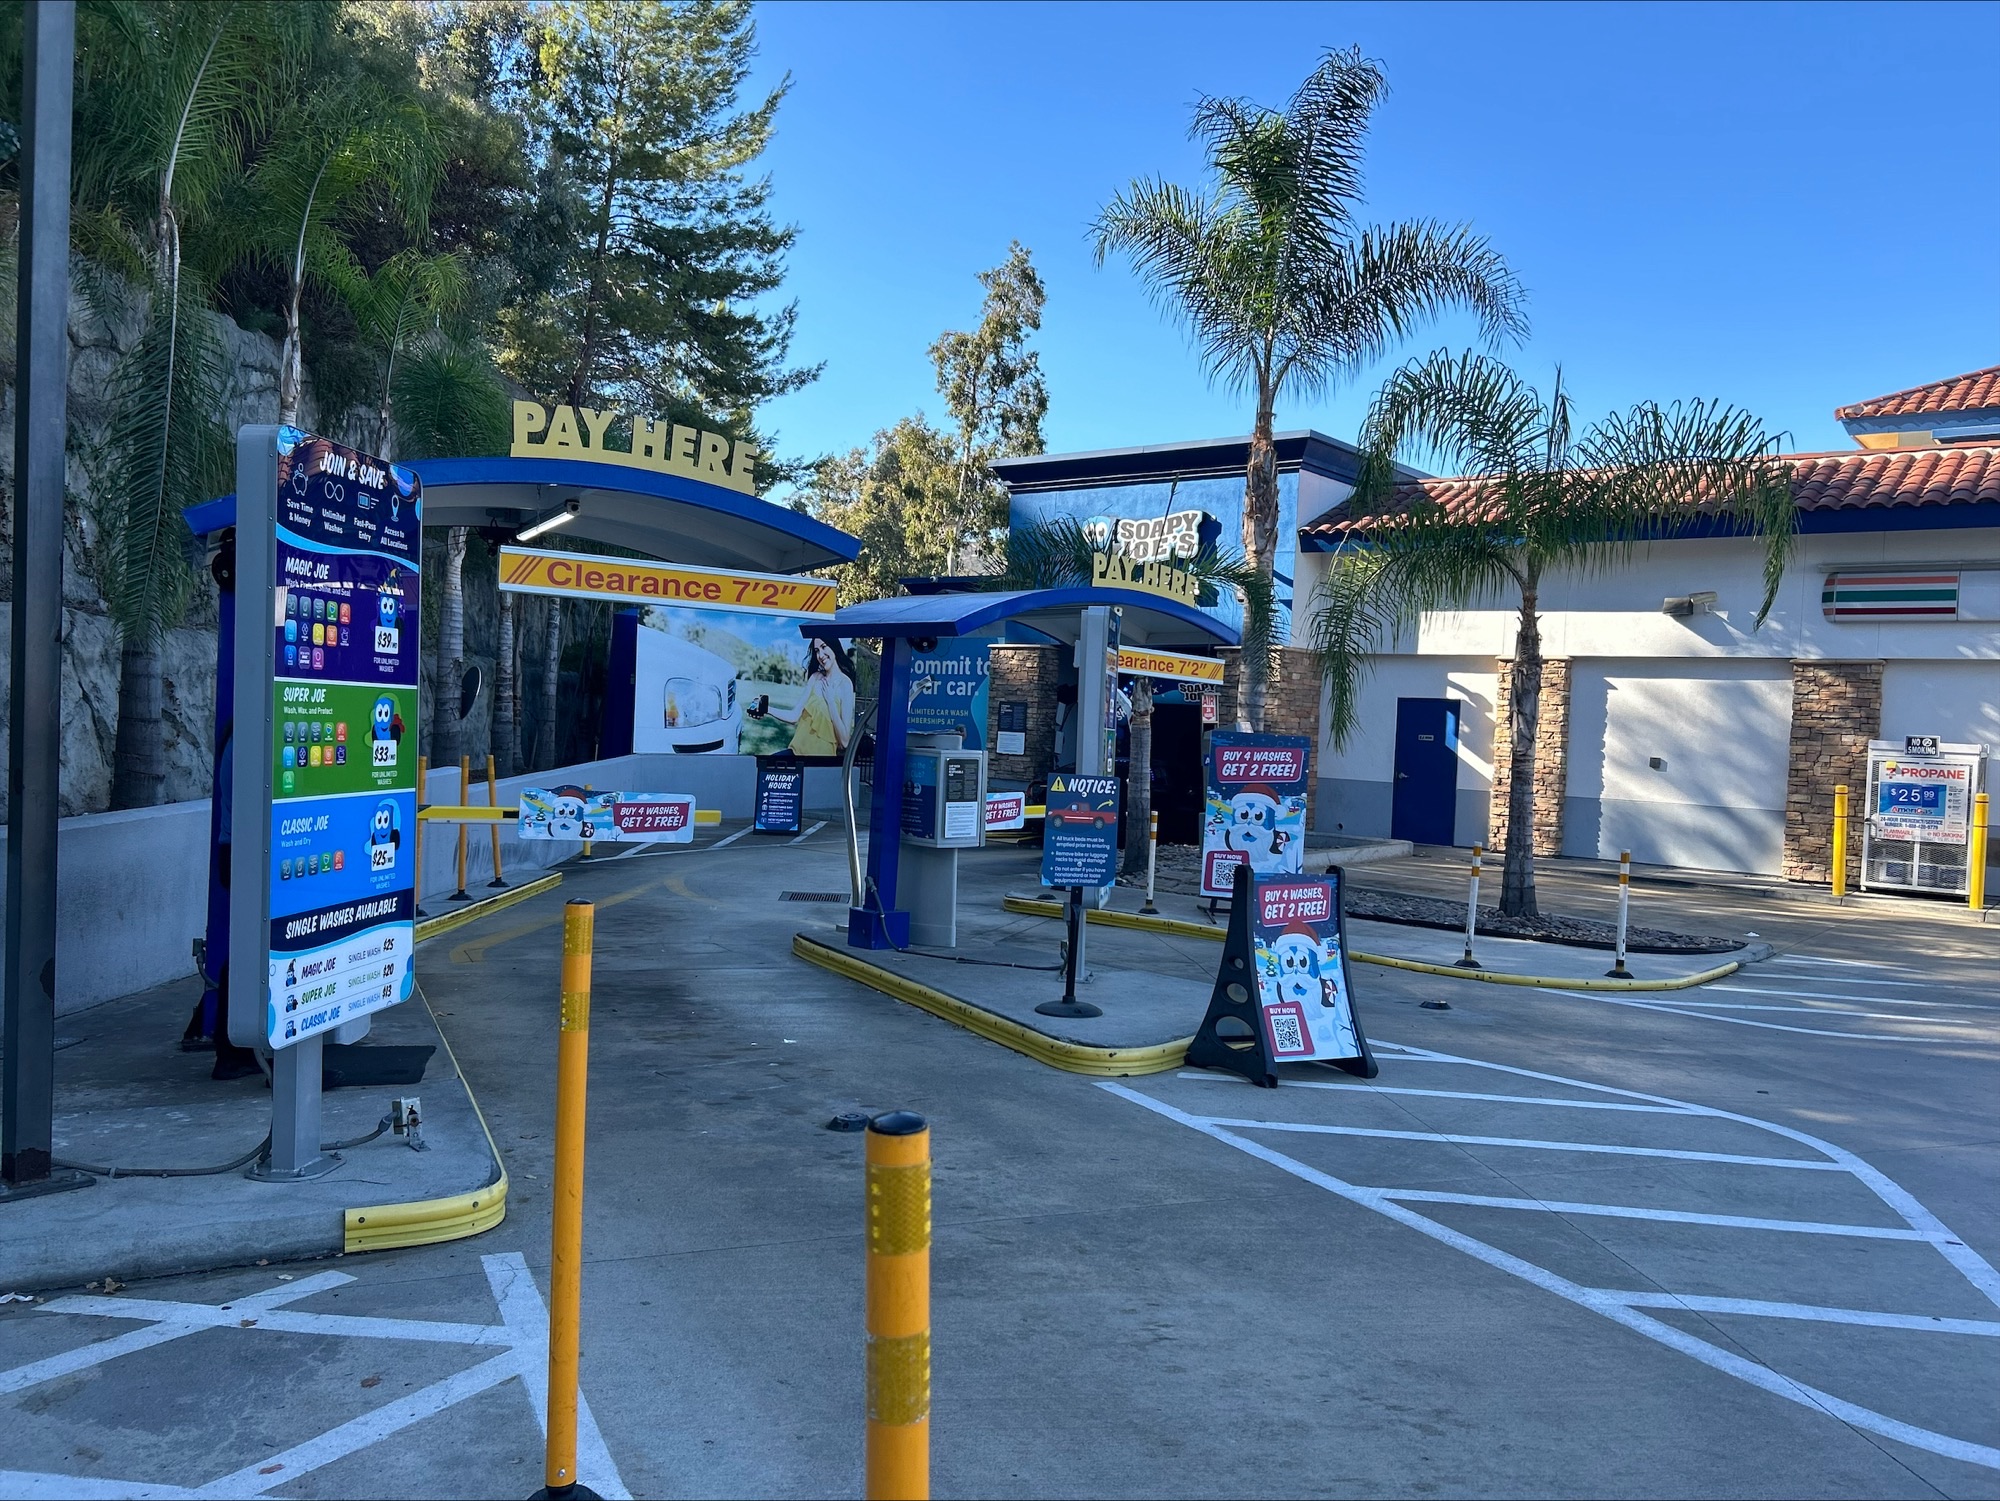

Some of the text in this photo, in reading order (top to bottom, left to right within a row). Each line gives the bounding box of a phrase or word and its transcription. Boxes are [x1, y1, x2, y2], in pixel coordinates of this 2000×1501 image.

[513, 400, 758, 484] PAY HERE
[320, 451, 385, 489] JOIN & SAVE
[287, 499, 313, 513] Save Time
[289, 512, 311, 527] & Money
[322, 509, 345, 522] Unlimited
[324, 522, 343, 533] Washes
[354, 518, 376, 530] Fast-Pass
[1120, 513, 1198, 540] SOAPY
[359, 531, 371, 542] Entry
[384, 526, 399, 537] Access
[388, 539, 408, 550] Locations
[285, 557, 329, 579] MAGIC JOE
[1093, 552, 1198, 601] PAY HERE
[547, 562, 796, 606] Clearance 7'2"
[1118, 655, 1206, 675] earance 7'2"
[284, 687, 326, 702] SUPER JOE
[947, 681, 978, 696] car.
[1179, 683, 1215, 692] SOAPY
[1203, 695, 1214, 705] AIR
[1912, 738, 1920, 746] NO
[1223, 752, 1293, 762] BUY 4 WASHES,
[1908, 746, 1935, 754] SMOKING
[1222, 764, 1297, 777] GET 2 FREE!
[1902, 768, 1965, 779] PROPANE
[765, 774, 796, 782] HOLIDAY
[1068, 779, 1116, 794] NOTICE:
[620, 806, 638, 816] BUY
[646, 806, 680, 816] WASHES,
[986, 811, 997, 820] GET
[1003, 808, 1019, 817] FREE!
[281, 815, 329, 835] CLASSIC JOE
[621, 816, 684, 828] GET 2 FREE!
[282, 840, 294, 848] Wash
[294, 838, 302, 846] and
[1265, 887, 1324, 902] BUY 4 WASHES,
[1264, 900, 1326, 919] GET 2 FREE!
[286, 897, 397, 939] SINGLE WASHES AVAILABLE
[302, 938, 394, 979] MAGIC JOE SINGLE WASH $25
[301, 963, 394, 1004] SUPER JOE SINGLE WASH $20
[301, 985, 392, 1031] CLASSIC JOE SINGLE WASH $13
